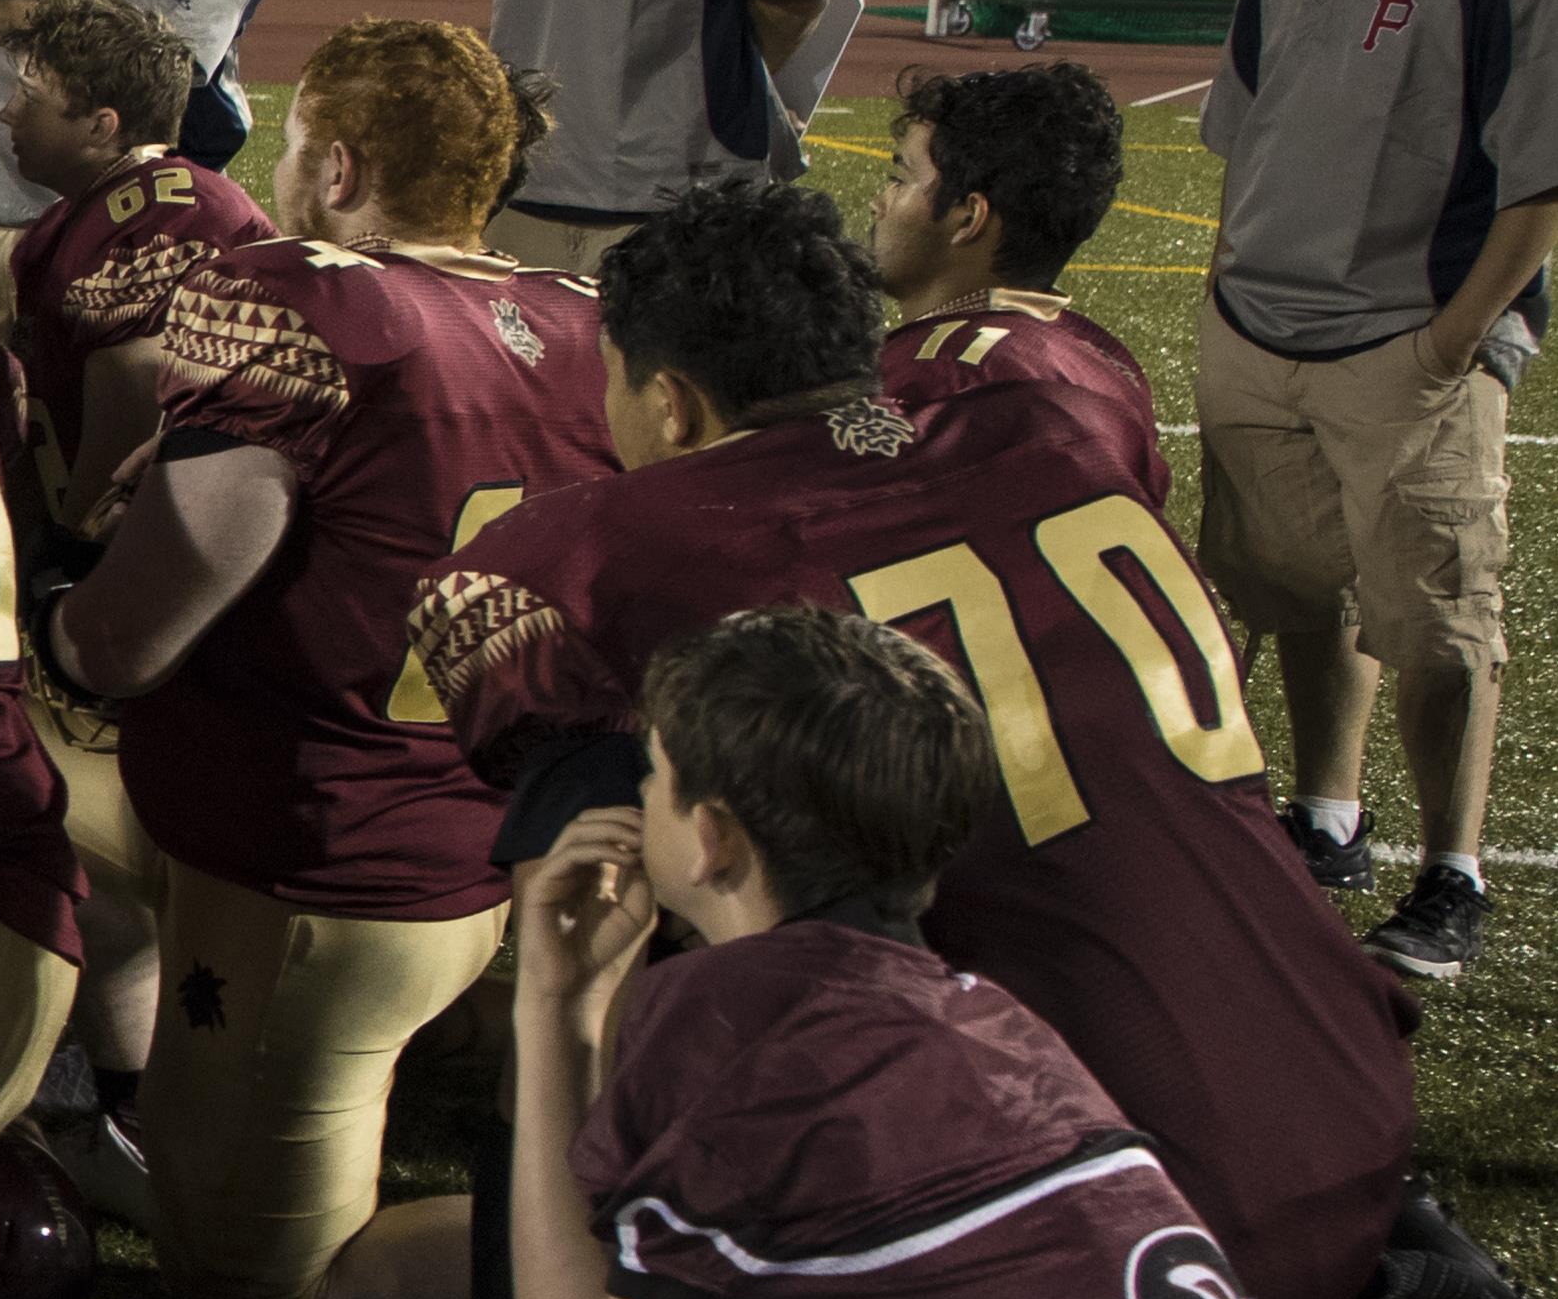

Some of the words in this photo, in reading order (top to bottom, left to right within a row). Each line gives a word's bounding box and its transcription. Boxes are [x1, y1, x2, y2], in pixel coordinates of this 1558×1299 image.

[105, 176, 196, 224] 62
[913, 319, 1011, 367] 11
[845, 494, 1266, 848] 70
